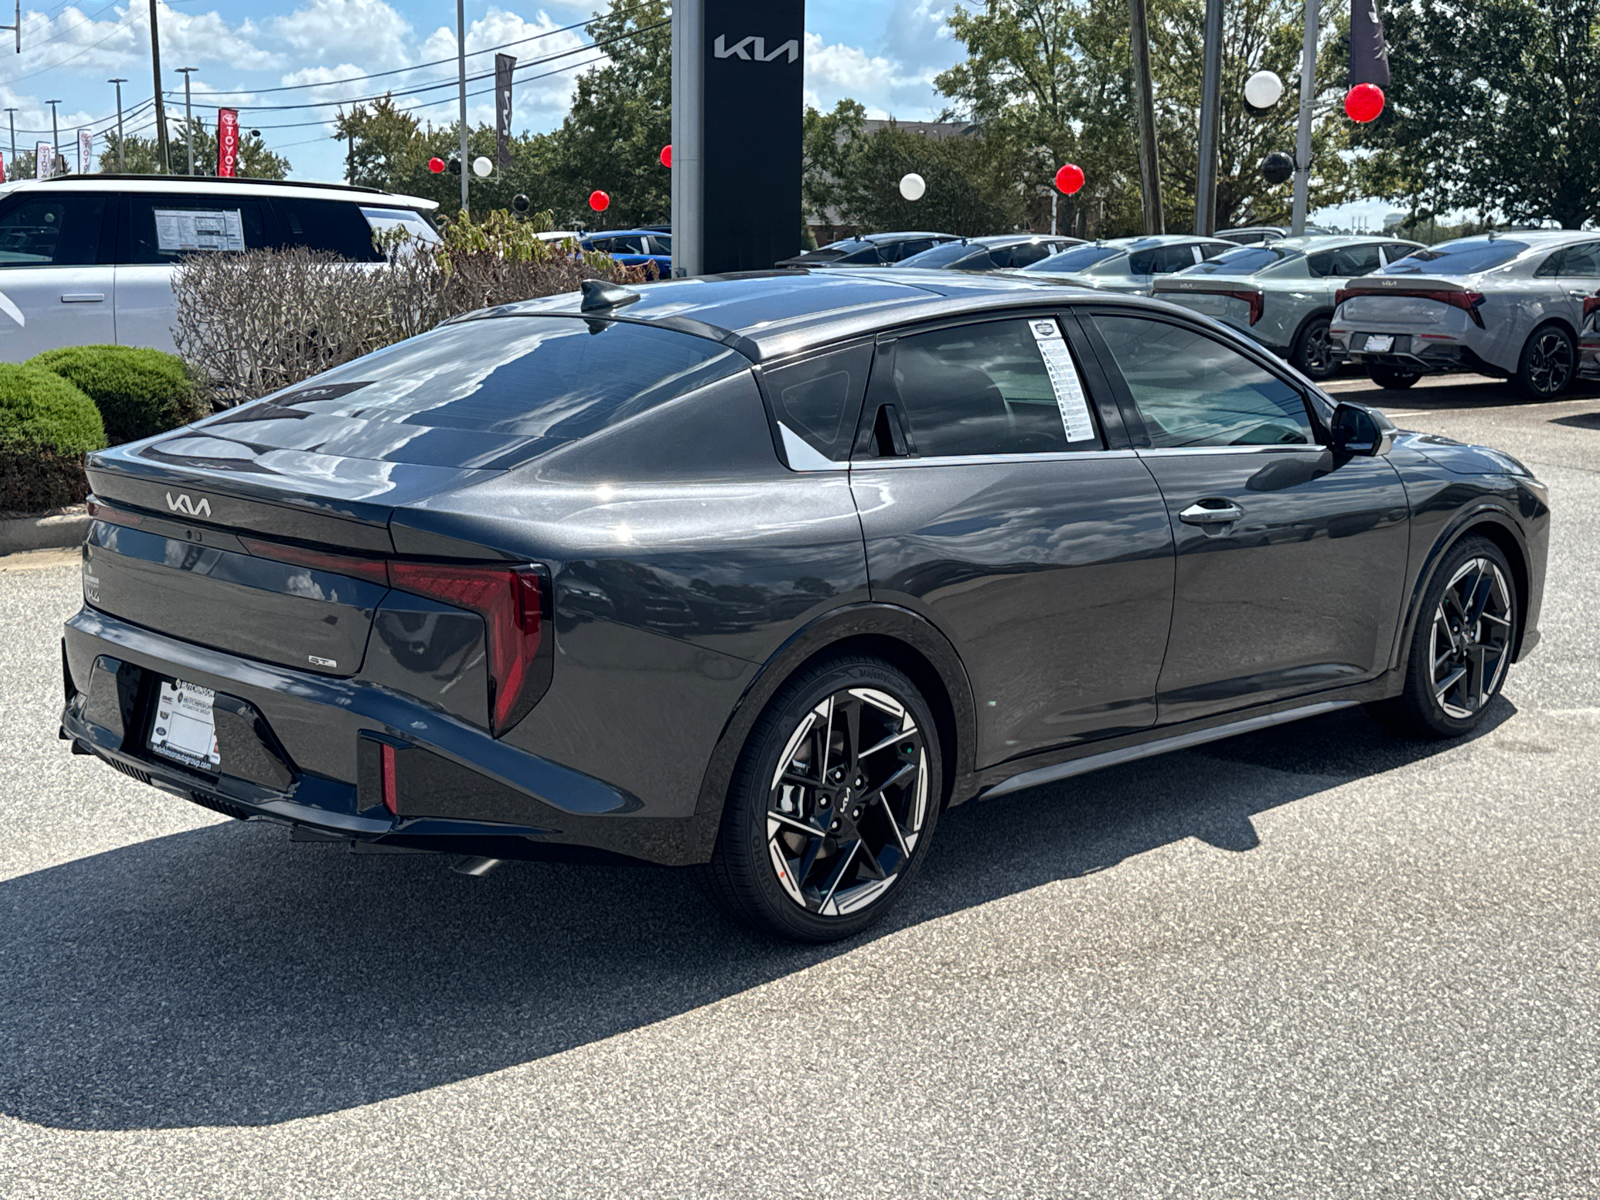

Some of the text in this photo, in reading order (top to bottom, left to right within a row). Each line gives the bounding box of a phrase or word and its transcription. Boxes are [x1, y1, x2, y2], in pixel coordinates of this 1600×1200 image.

[714, 33, 798, 64] KIA
[224, 126, 234, 178] TOYOT
[166, 491, 211, 518] KIA
